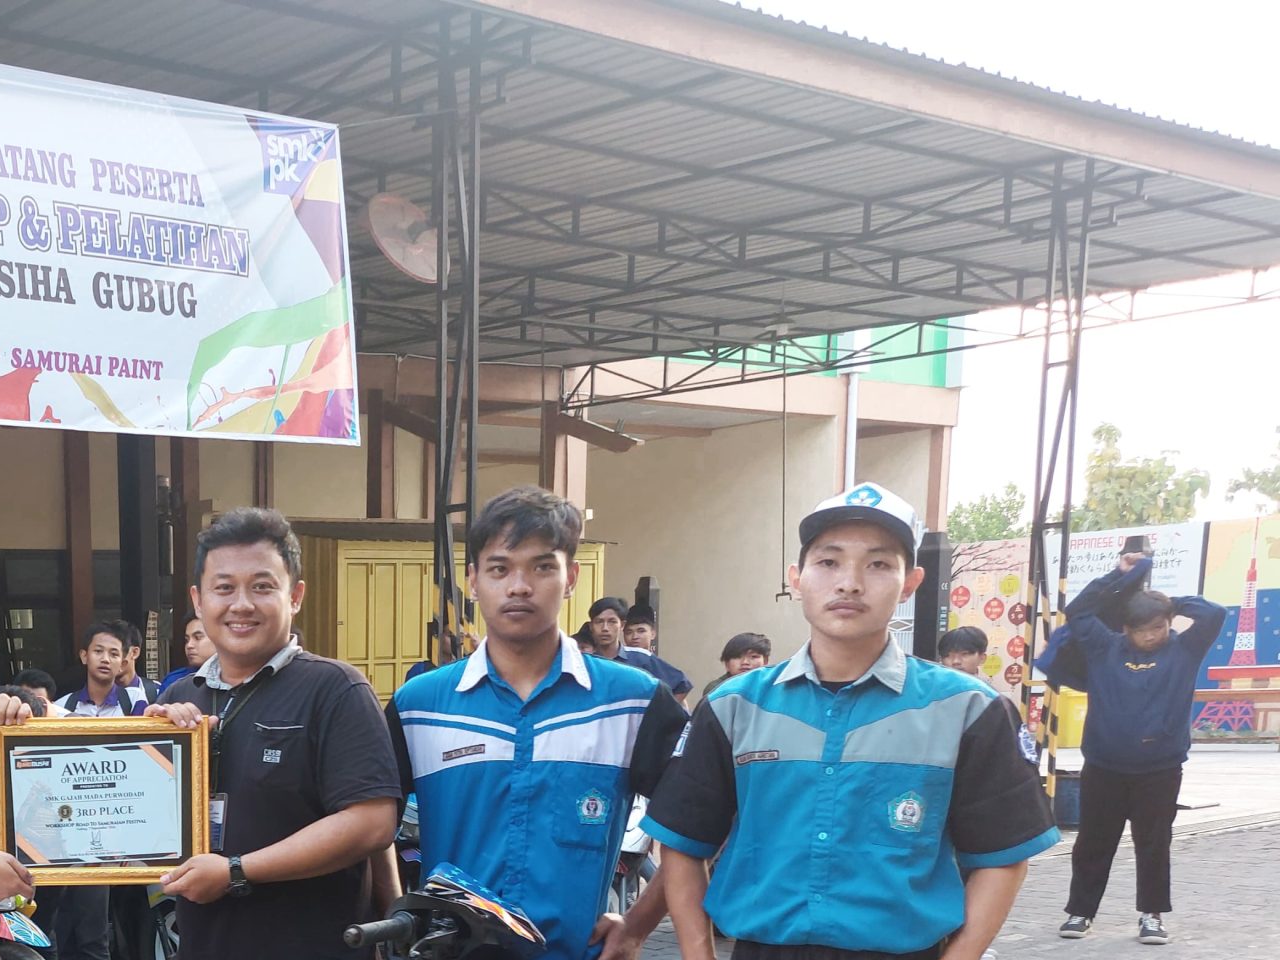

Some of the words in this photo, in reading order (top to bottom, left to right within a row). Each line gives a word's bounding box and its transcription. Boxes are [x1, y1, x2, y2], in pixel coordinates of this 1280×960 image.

[90, 158, 205, 207] PESERTA
[269, 154, 302, 190] pk
[18, 195, 52, 252] &
[53, 201, 250, 278] PELATIHAN
[92, 271, 198, 318] GUBUG
[11, 347, 103, 376] SAMURAI
[108, 356, 164, 381] PAINT
[1070, 535, 1114, 550] APANESE
[61, 759, 127, 777] AWARD
[73, 774, 128, 783] APPRECIATION
[75, 808, 97, 817] 3RD
[99, 806, 135, 816] PLACE
